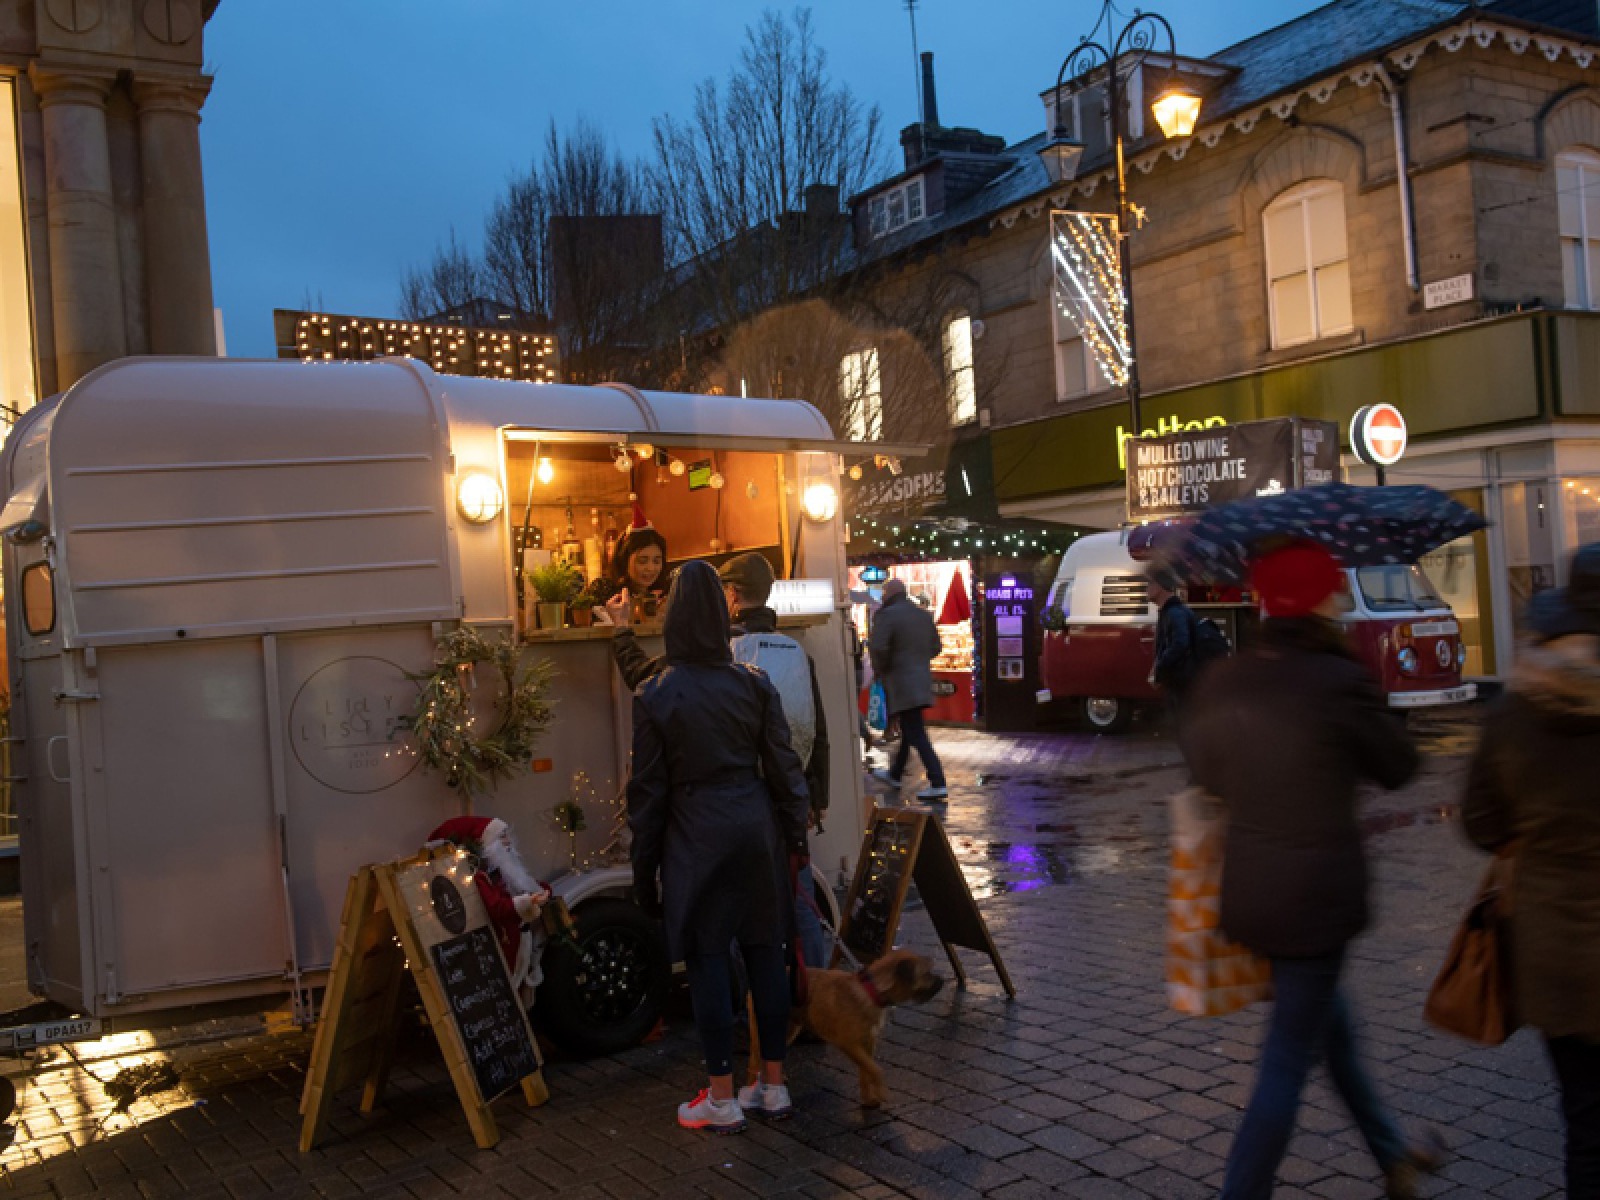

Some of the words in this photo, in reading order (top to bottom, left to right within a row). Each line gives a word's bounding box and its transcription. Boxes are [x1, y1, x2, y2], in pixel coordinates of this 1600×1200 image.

[1428, 278, 1467, 293] MARKET
[1433, 290, 1462, 304] PLACE
[297, 315, 556, 384] COFFEE
[1137, 442, 1192, 466] MULLED
[1193, 437, 1230, 460] WINE
[1137, 467, 1166, 488] HOT
[1168, 458, 1247, 485] CHOCOLATE
[1150, 483, 1210, 508] BAILEYS
[325, 695, 393, 716] LILY
[301, 717, 400, 741] LISTE
